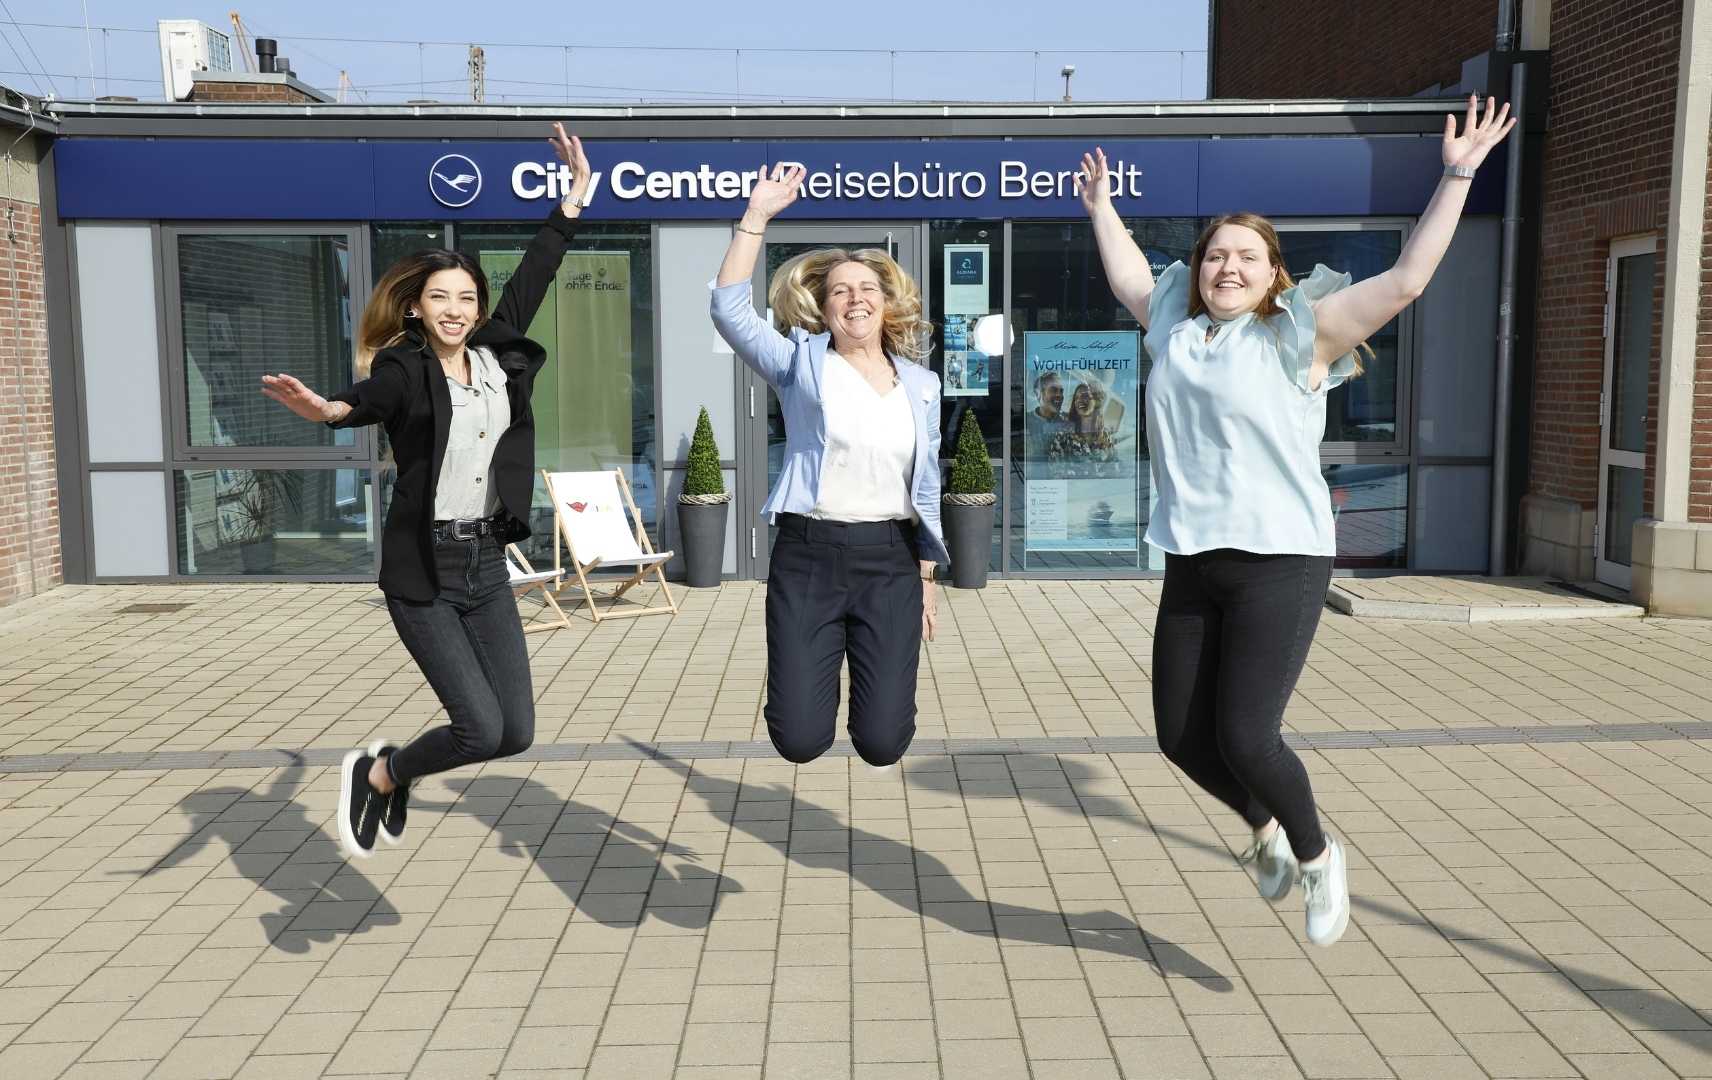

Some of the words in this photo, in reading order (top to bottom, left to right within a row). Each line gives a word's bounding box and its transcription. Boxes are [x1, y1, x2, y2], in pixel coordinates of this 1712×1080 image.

[511, 161, 602, 207] City
[610, 161, 758, 199] Center
[1150, 262, 1167, 271] cken
[1033, 357, 1131, 371] WOHLFÜHLZEIT
